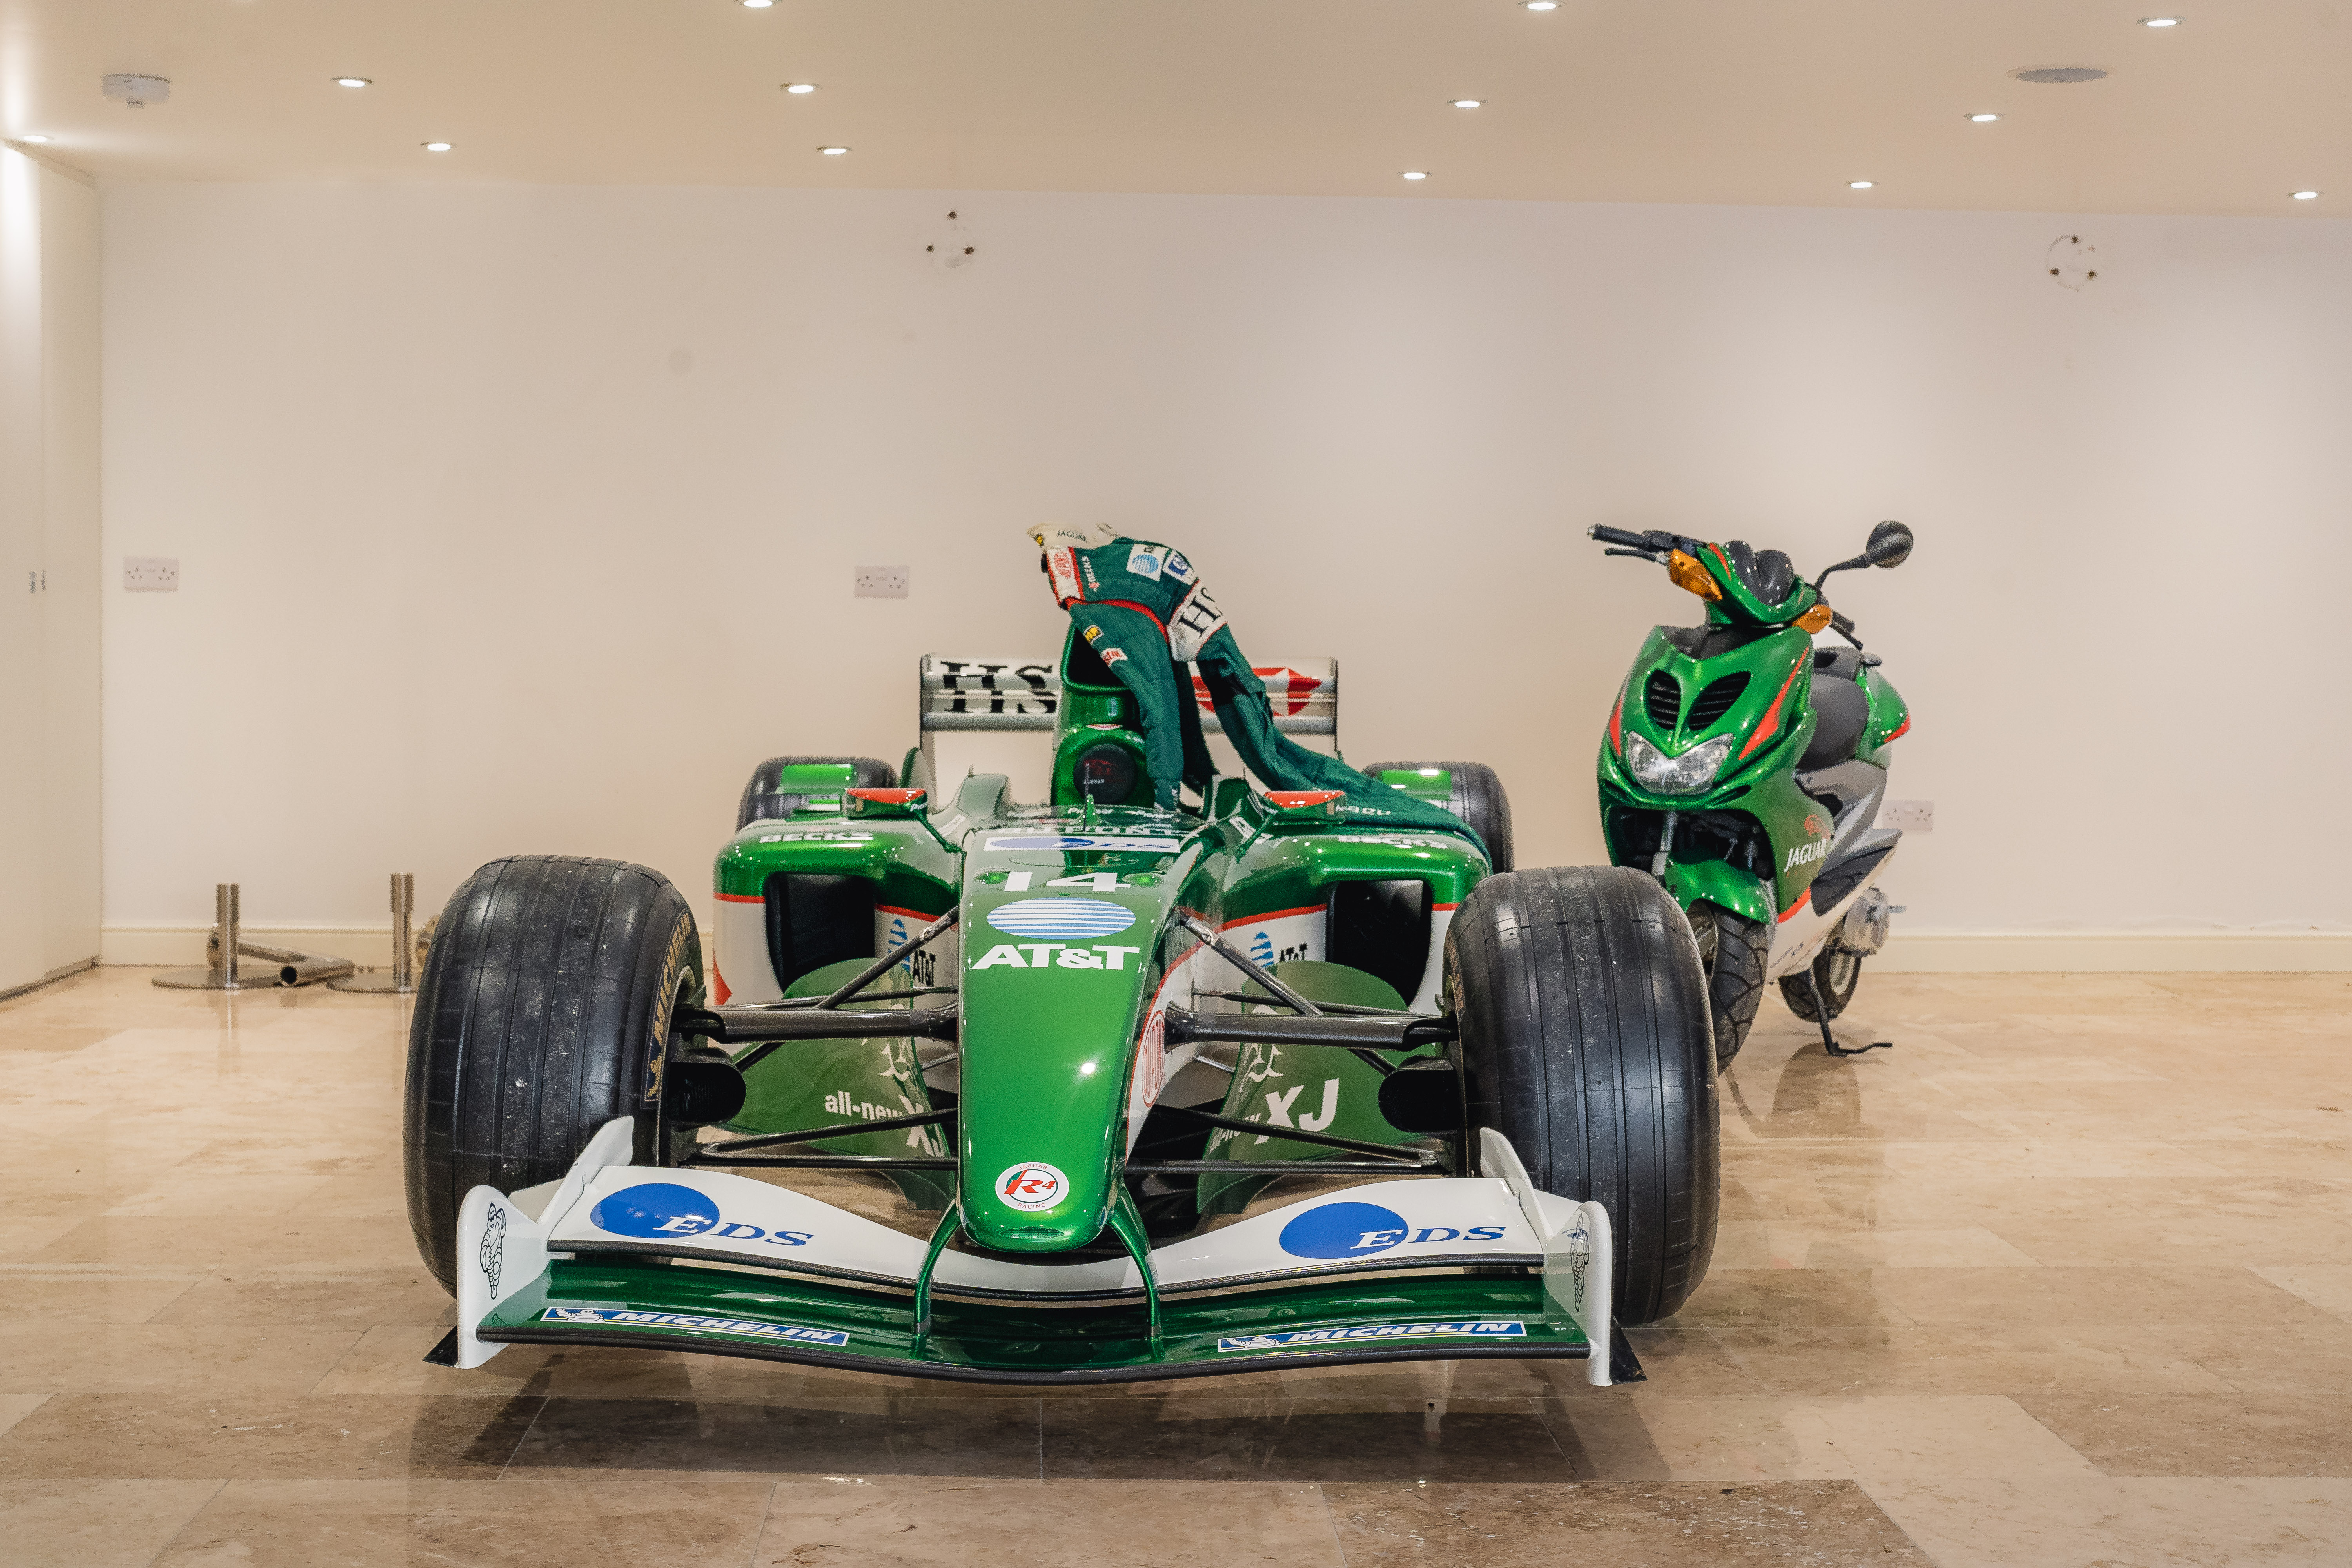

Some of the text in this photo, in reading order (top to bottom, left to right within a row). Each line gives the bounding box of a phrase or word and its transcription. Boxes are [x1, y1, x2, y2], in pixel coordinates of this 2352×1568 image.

[1136, 809, 1175, 819] Pioneer
[1004, 871, 1131, 892] 14
[913, 949, 936, 987] AT&T
[971, 944, 1140, 970] AT&T
[654, 913, 690, 1047] MICHELIN
[1254, 1078, 1339, 1145] XJ
[652, 1216, 814, 1246] EDS
[1350, 1226, 1506, 1249] EDS
[611, 1312, 843, 1339] MICHELIN
[1288, 1323, 1513, 1342] MICHELIN
